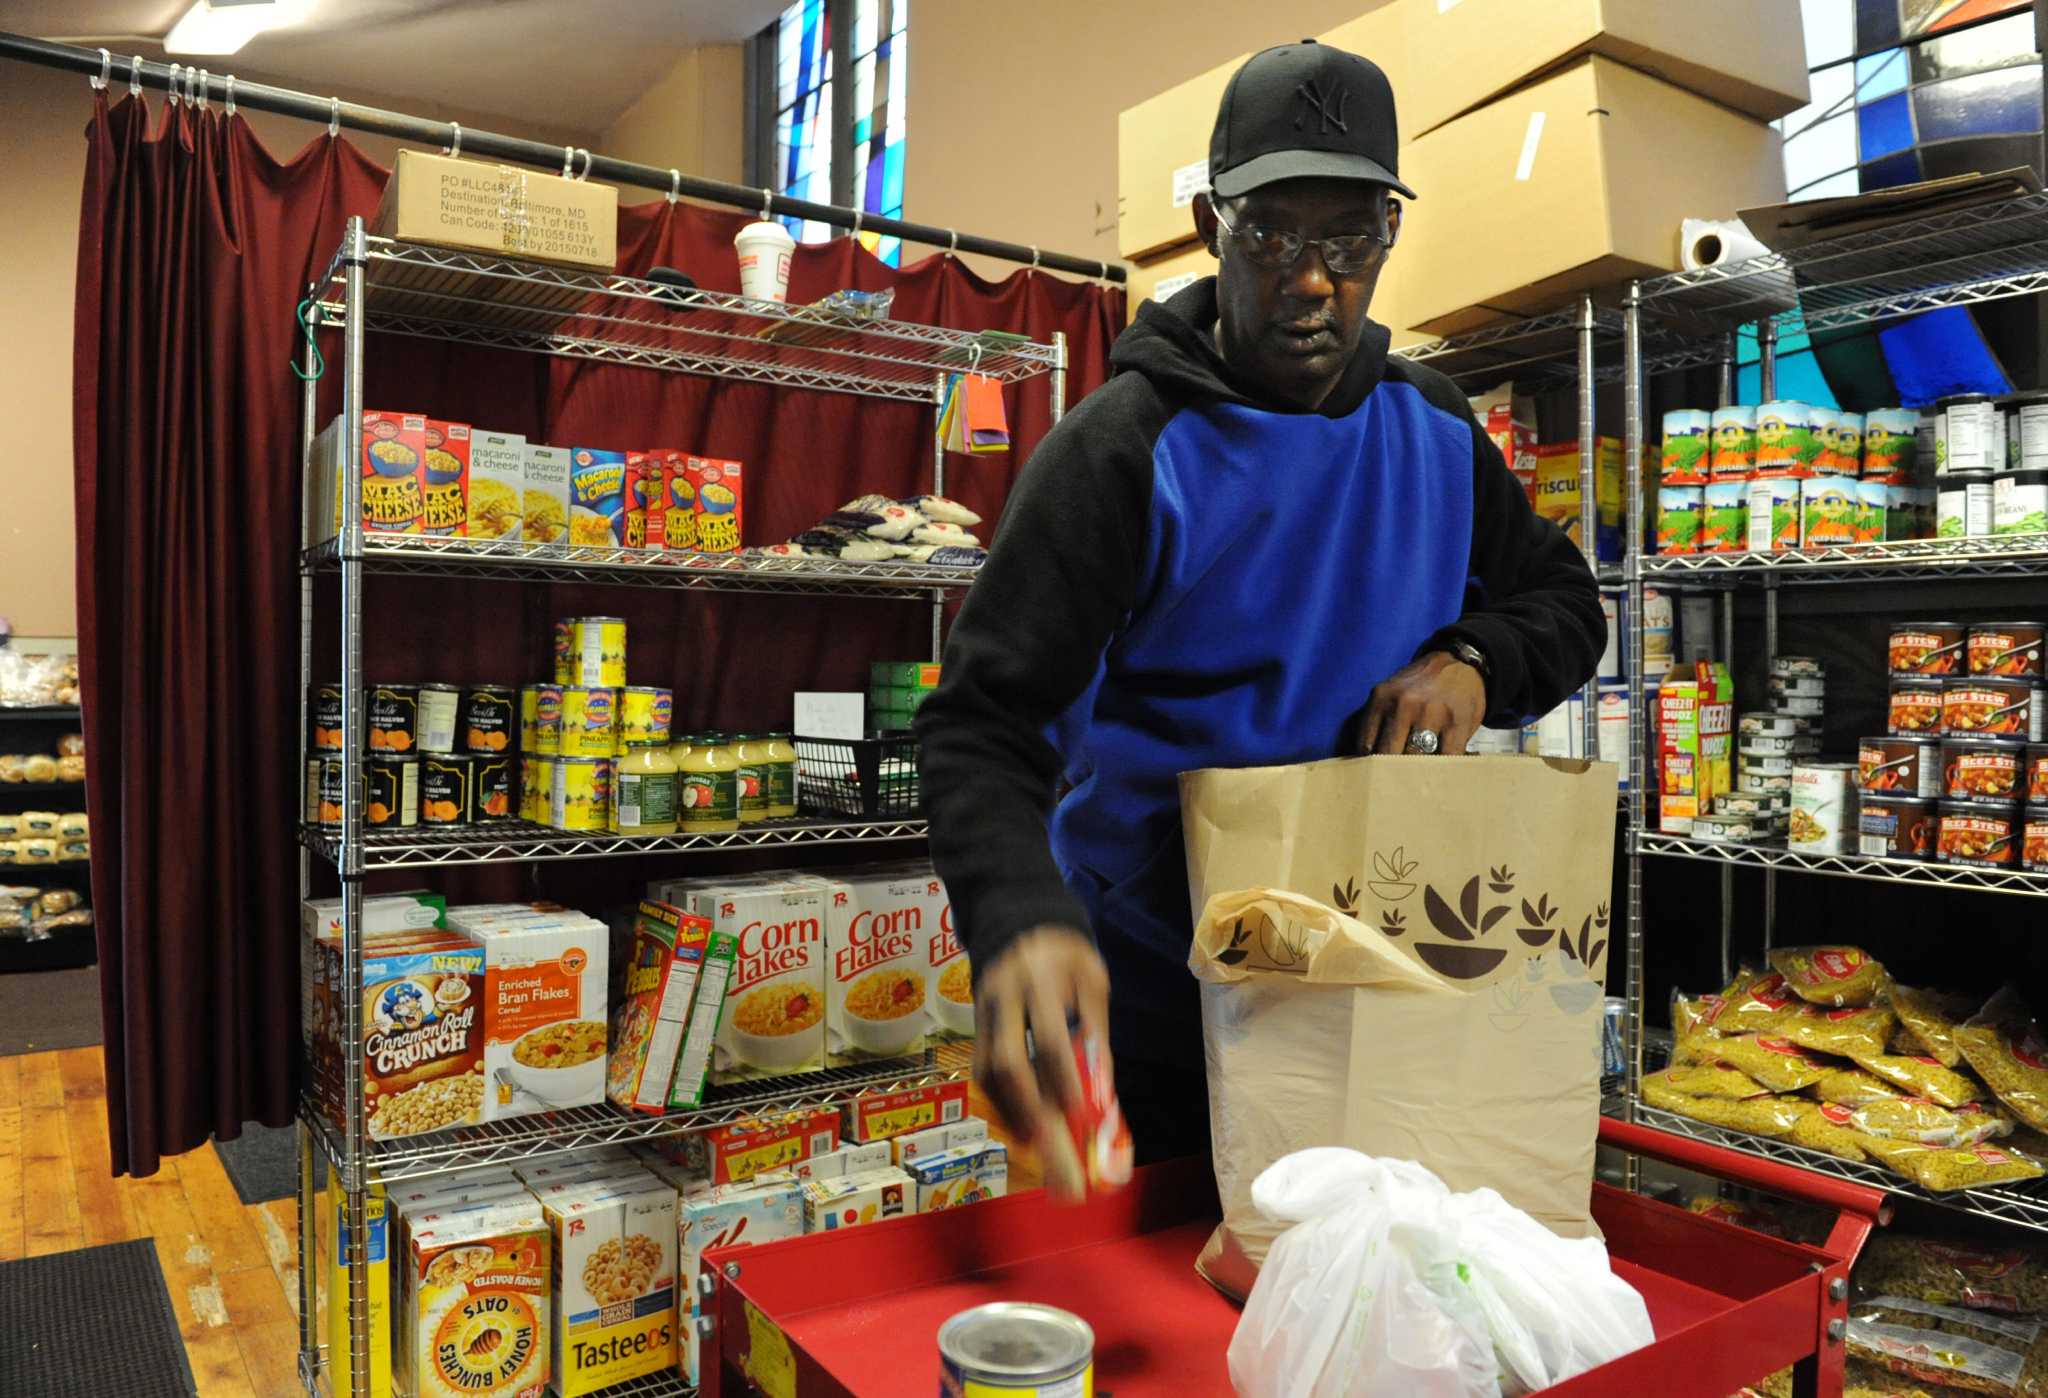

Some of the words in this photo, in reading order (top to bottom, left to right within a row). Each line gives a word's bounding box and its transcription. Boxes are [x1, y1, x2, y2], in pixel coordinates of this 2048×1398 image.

[441, 175, 459, 187] PO
[440, 202, 485, 218] Number
[487, 208, 498, 218] of
[550, 217, 561, 227] of
[568, 207, 585, 218] MD
[440, 214, 463, 226] Can
[466, 217, 498, 231] Code:
[530, 238, 544, 250] by
[472, 449, 520, 461] macaroni
[484, 460, 519, 471] cheese
[362, 496, 423, 523] CHEESE
[1907, 636, 1938, 647] STEW
[1980, 637, 2010, 648] STEW
[1970, 692, 2006, 704] STEW
[1960, 757, 1992, 767] BEEF
[1972, 819, 2006, 833] STEW
[848, 906, 921, 947] Corn
[737, 918, 818, 959] Corn
[431, 955, 482, 973] NEW!
[731, 945, 809, 985] lakes
[834, 934, 913, 979] Flakes
[498, 976, 542, 991] Enriched
[498, 992, 528, 1005] Bran
[532, 987, 570, 1001] Flakes
[366, 1023, 440, 1057] Cinnamon
[441, 1006, 475, 1036] Roll
[376, 1030, 467, 1073] CRUNCH
[473, 1275, 514, 1288] ROASTED
[463, 1297, 509, 1319] OATS
[499, 1327, 532, 1379] HONEY
[572, 1323, 672, 1372] Tasteeos
[439, 1343, 493, 1389] BUNCHES
